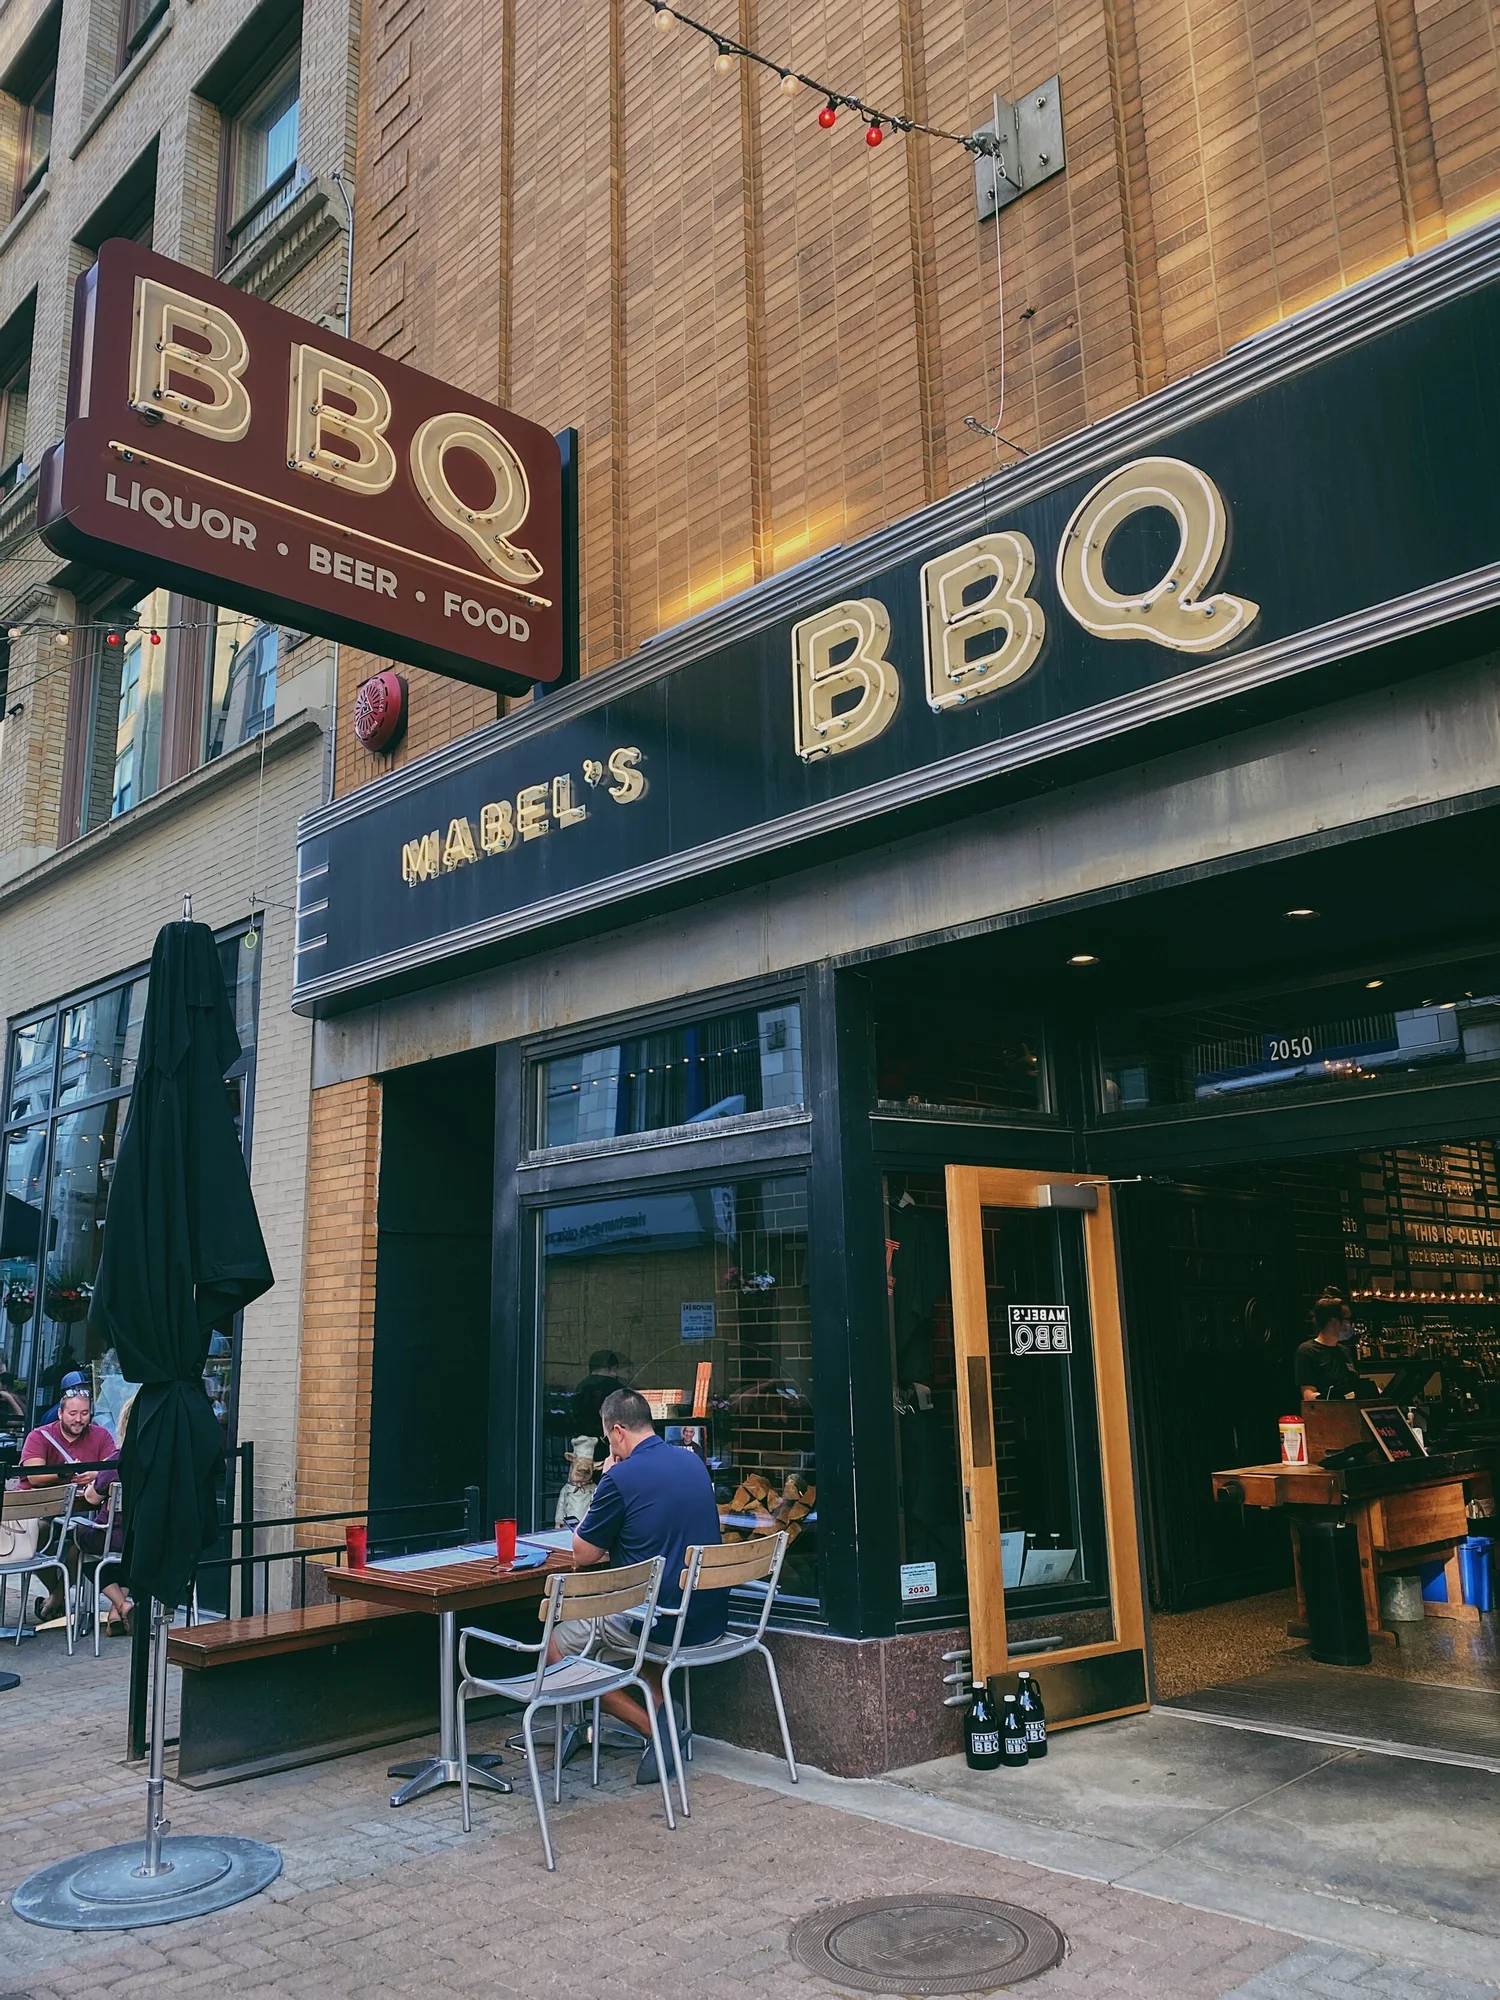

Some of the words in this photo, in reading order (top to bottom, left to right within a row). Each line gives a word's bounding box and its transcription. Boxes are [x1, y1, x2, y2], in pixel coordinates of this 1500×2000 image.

[129, 276, 544, 585] BBQ
[105, 473, 257, 551] LIQUOR
[308, 543, 399, 599] BEER
[443, 590, 531, 643] FOOD
[791, 456, 1261, 764] BBQ
[402, 746, 646, 888] MABEL'S
[1269, 1036, 1313, 1062] 2050
[1418, 1154, 1434, 1172] big
[1435, 1157, 1451, 1174] pig
[1421, 1177, 1452, 1197] turkey
[1442, 1226, 1454, 1244] IS
[1458, 1228, 1500, 1247] CLEVEL
[1408, 1249, 1429, 1266] pork
[1431, 1251, 1455, 1267] spare
[908, 1585, 930, 1595] 2020
[1025, 1722, 1046, 1730] ABEL'
[973, 1733, 999, 1741] MABEL'
